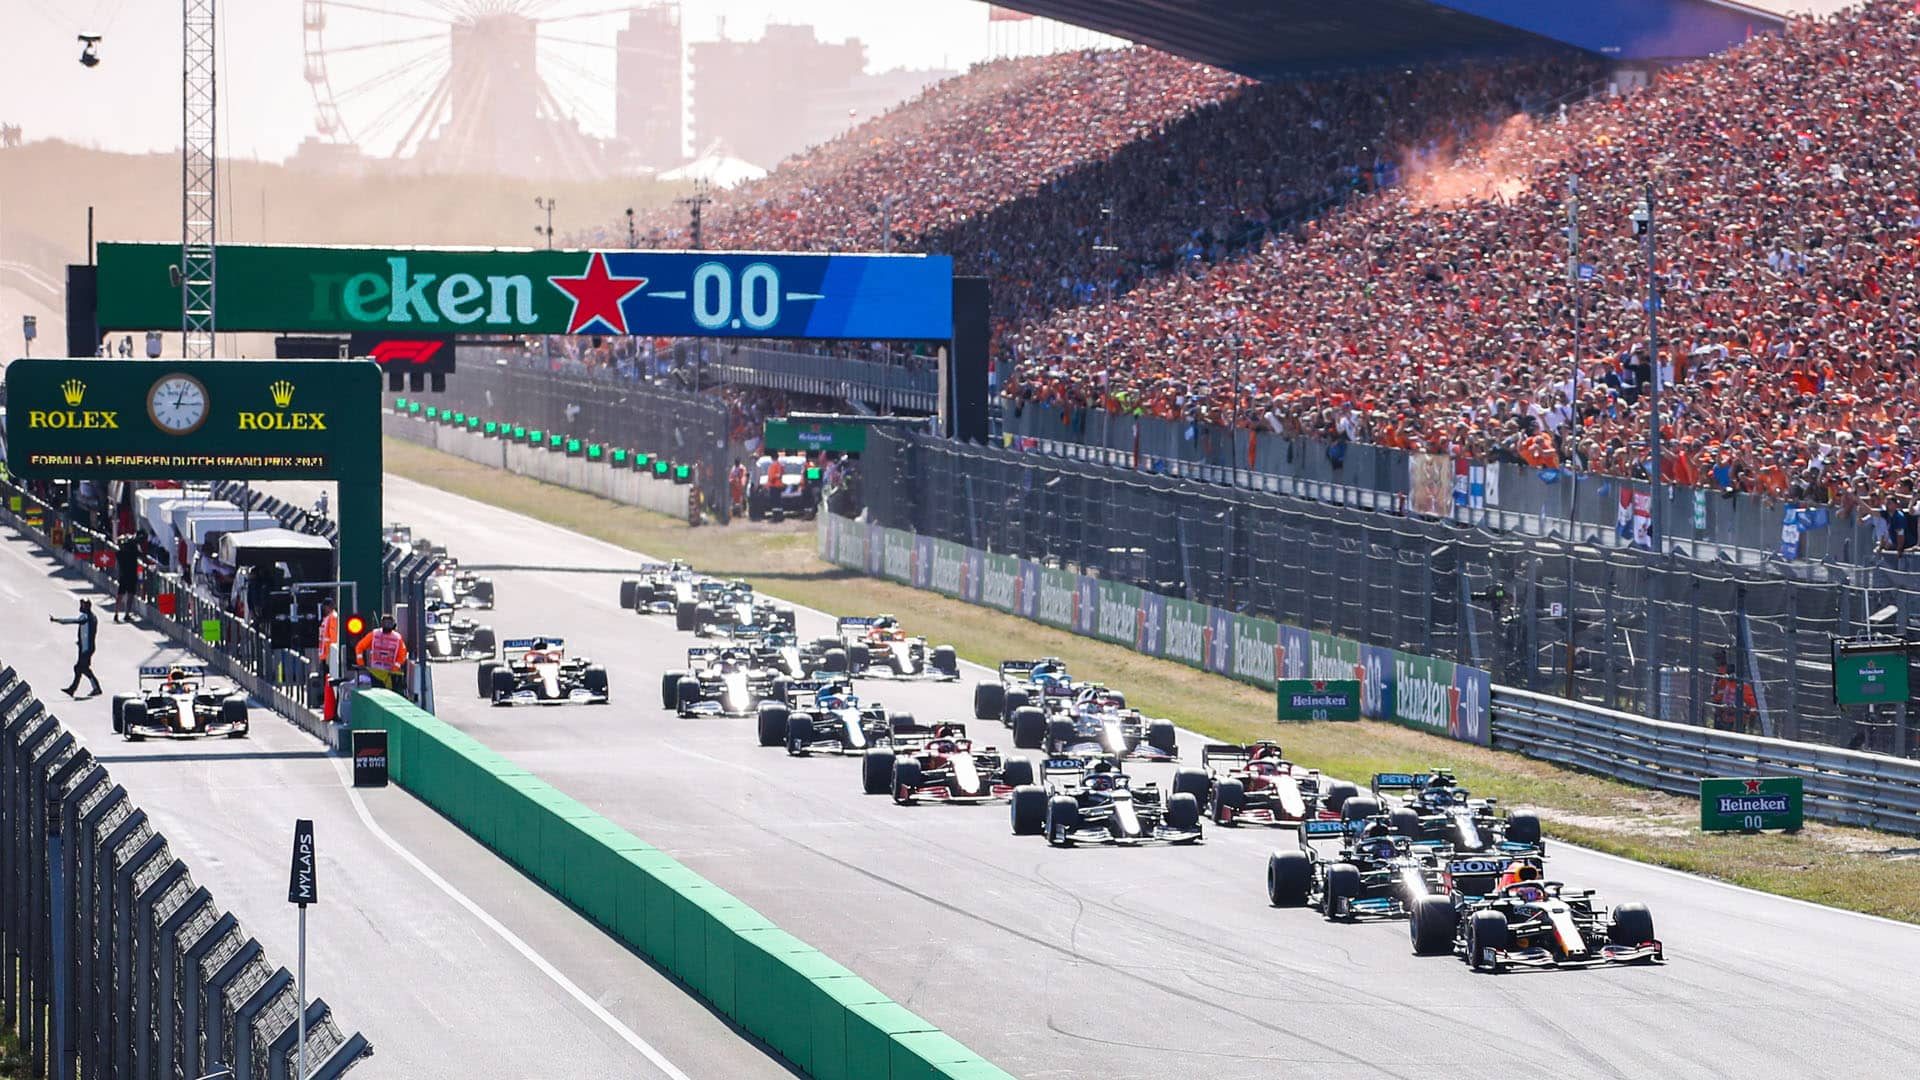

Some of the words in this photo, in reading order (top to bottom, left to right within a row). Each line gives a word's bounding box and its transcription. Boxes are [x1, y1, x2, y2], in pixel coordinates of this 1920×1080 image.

[29, 411, 119, 429] ROLEX
[238, 412, 327, 430] ROLEX
[31, 455, 93, 465] FORMULA
[105, 455, 170, 465] HEINEKEN
[173, 456, 215, 466] DUTCH
[217, 456, 262, 466] GRAND
[264, 456, 292, 466] PRIX
[1292, 696, 1346, 706] Heineken
[1396, 660, 1447, 728] Heineken
[1720, 797, 1786, 811] Heineken
[300, 833, 312, 898] MYLAPS
